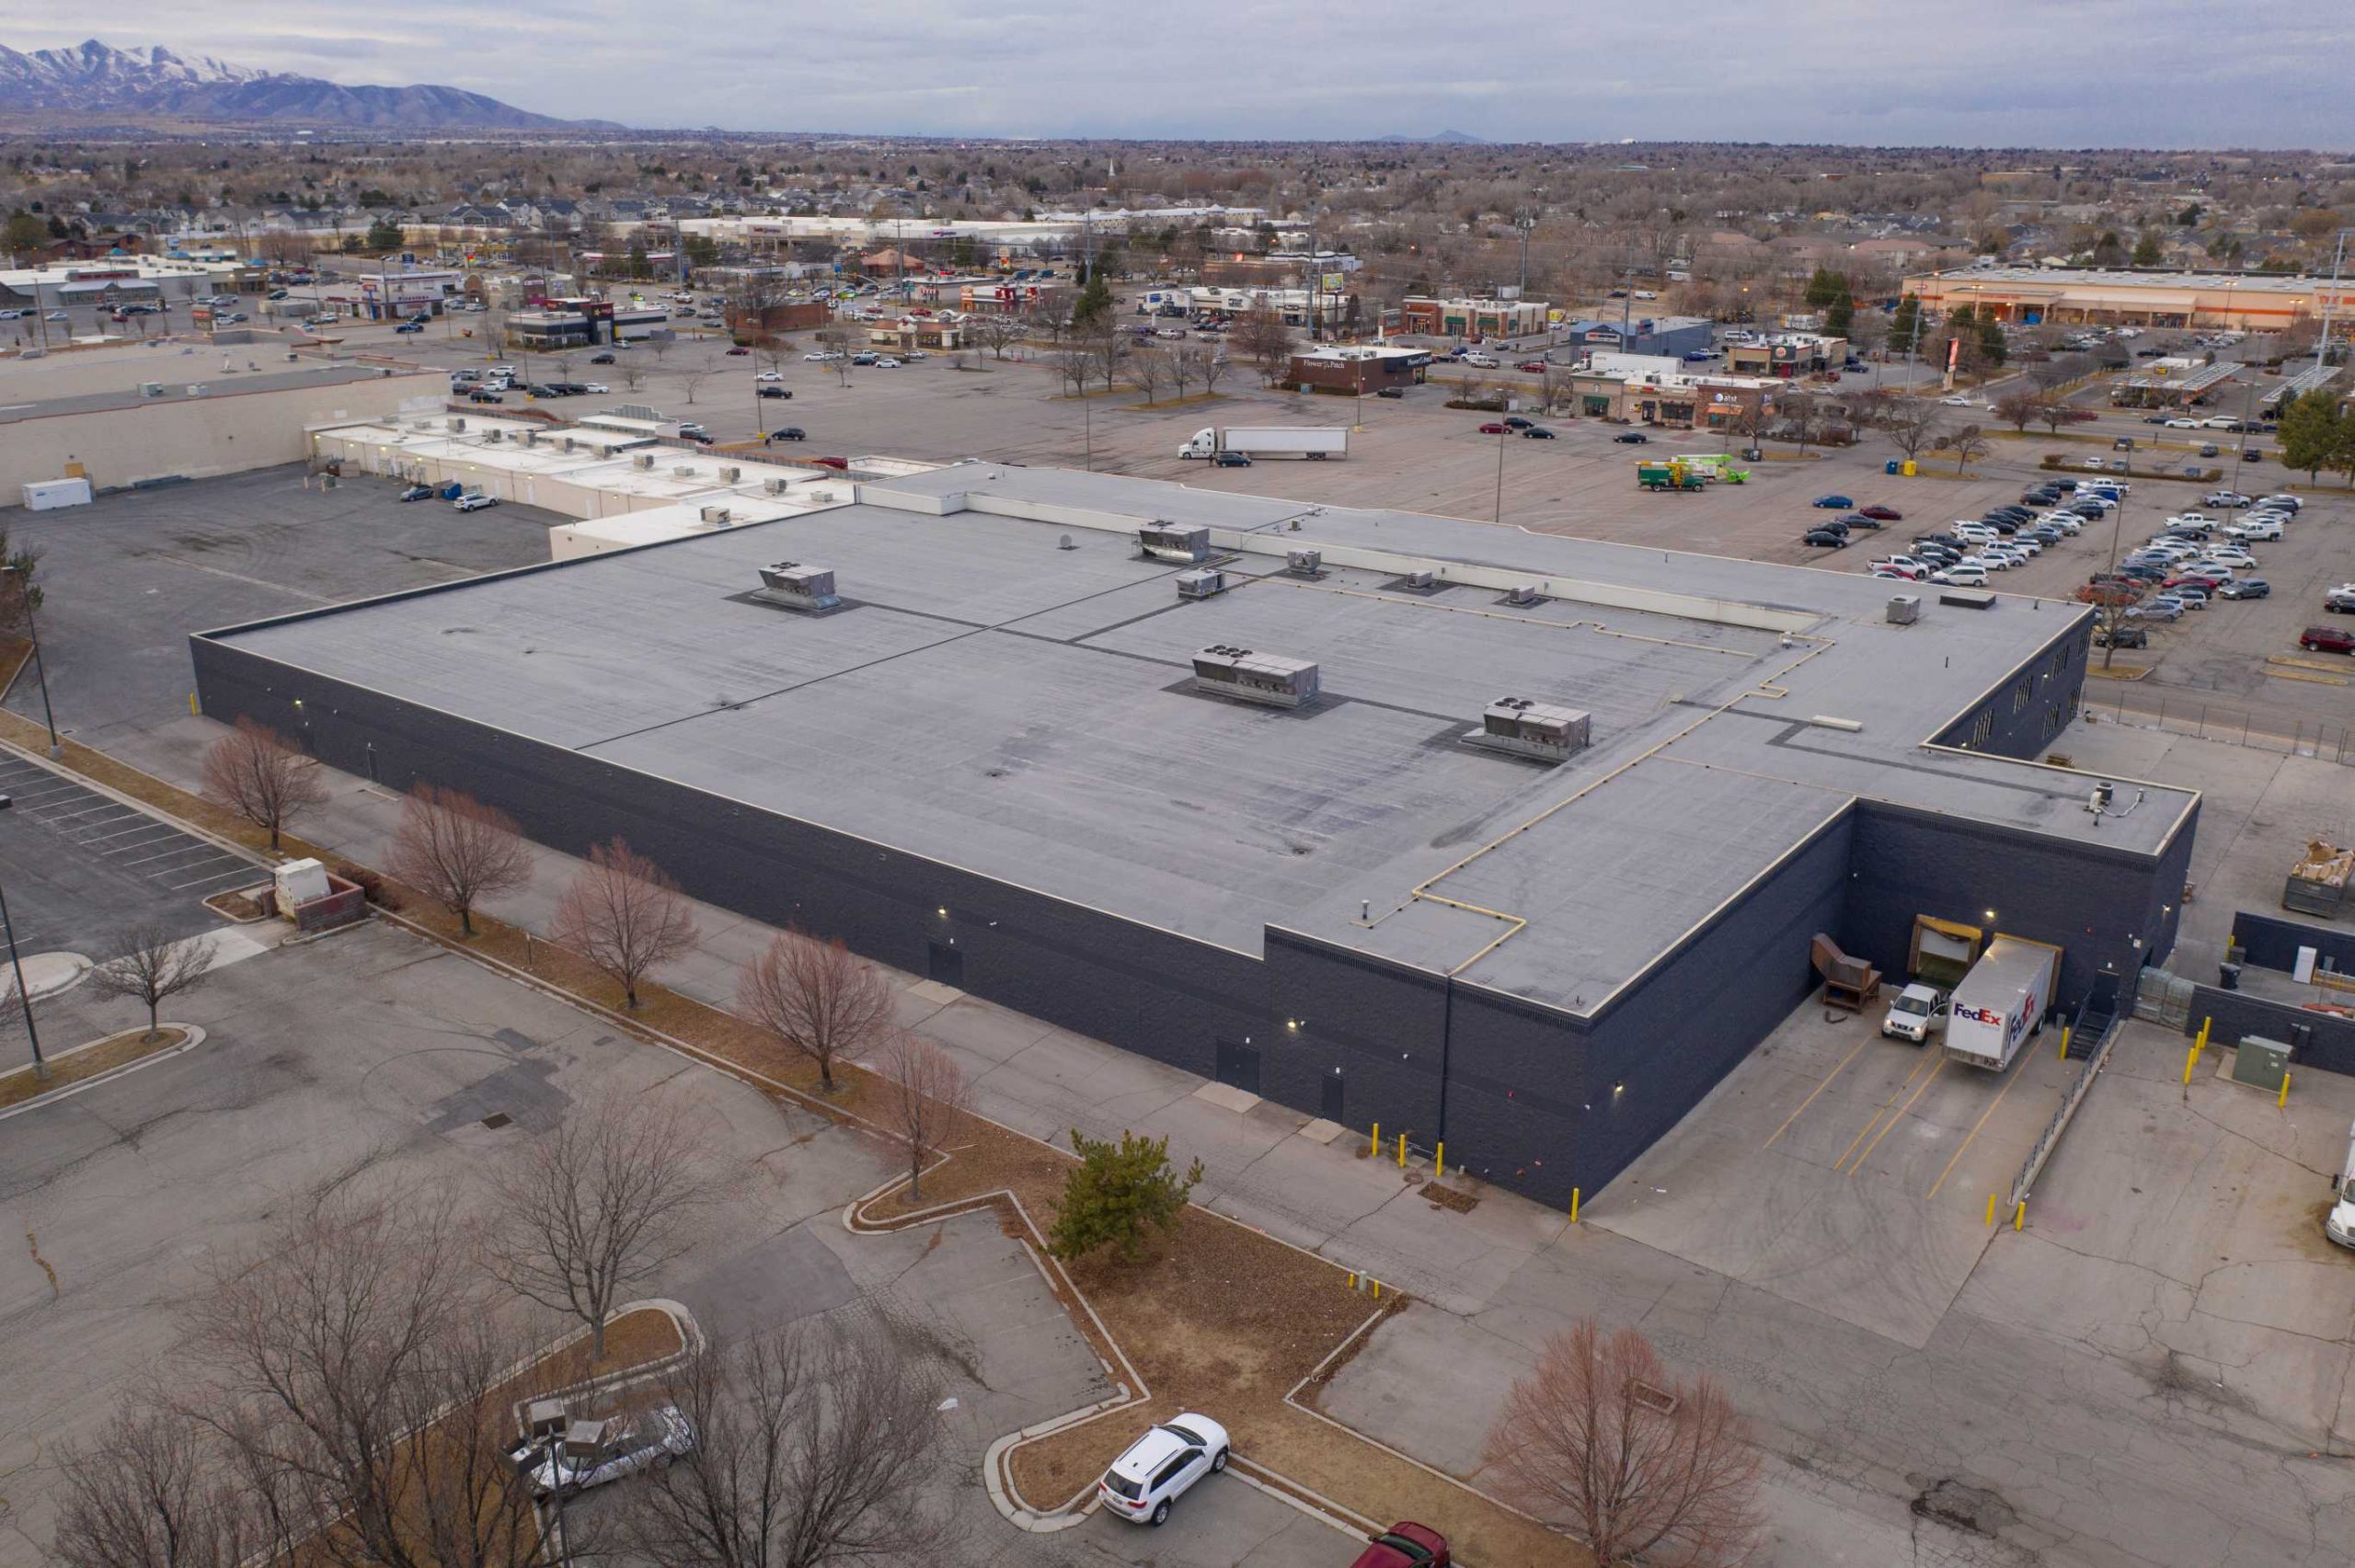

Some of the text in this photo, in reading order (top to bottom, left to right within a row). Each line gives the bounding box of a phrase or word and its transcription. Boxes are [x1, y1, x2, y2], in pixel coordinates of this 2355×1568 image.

[1304, 359, 1345, 369] Flower Patch
[1954, 1002, 2002, 1026] FedEx
